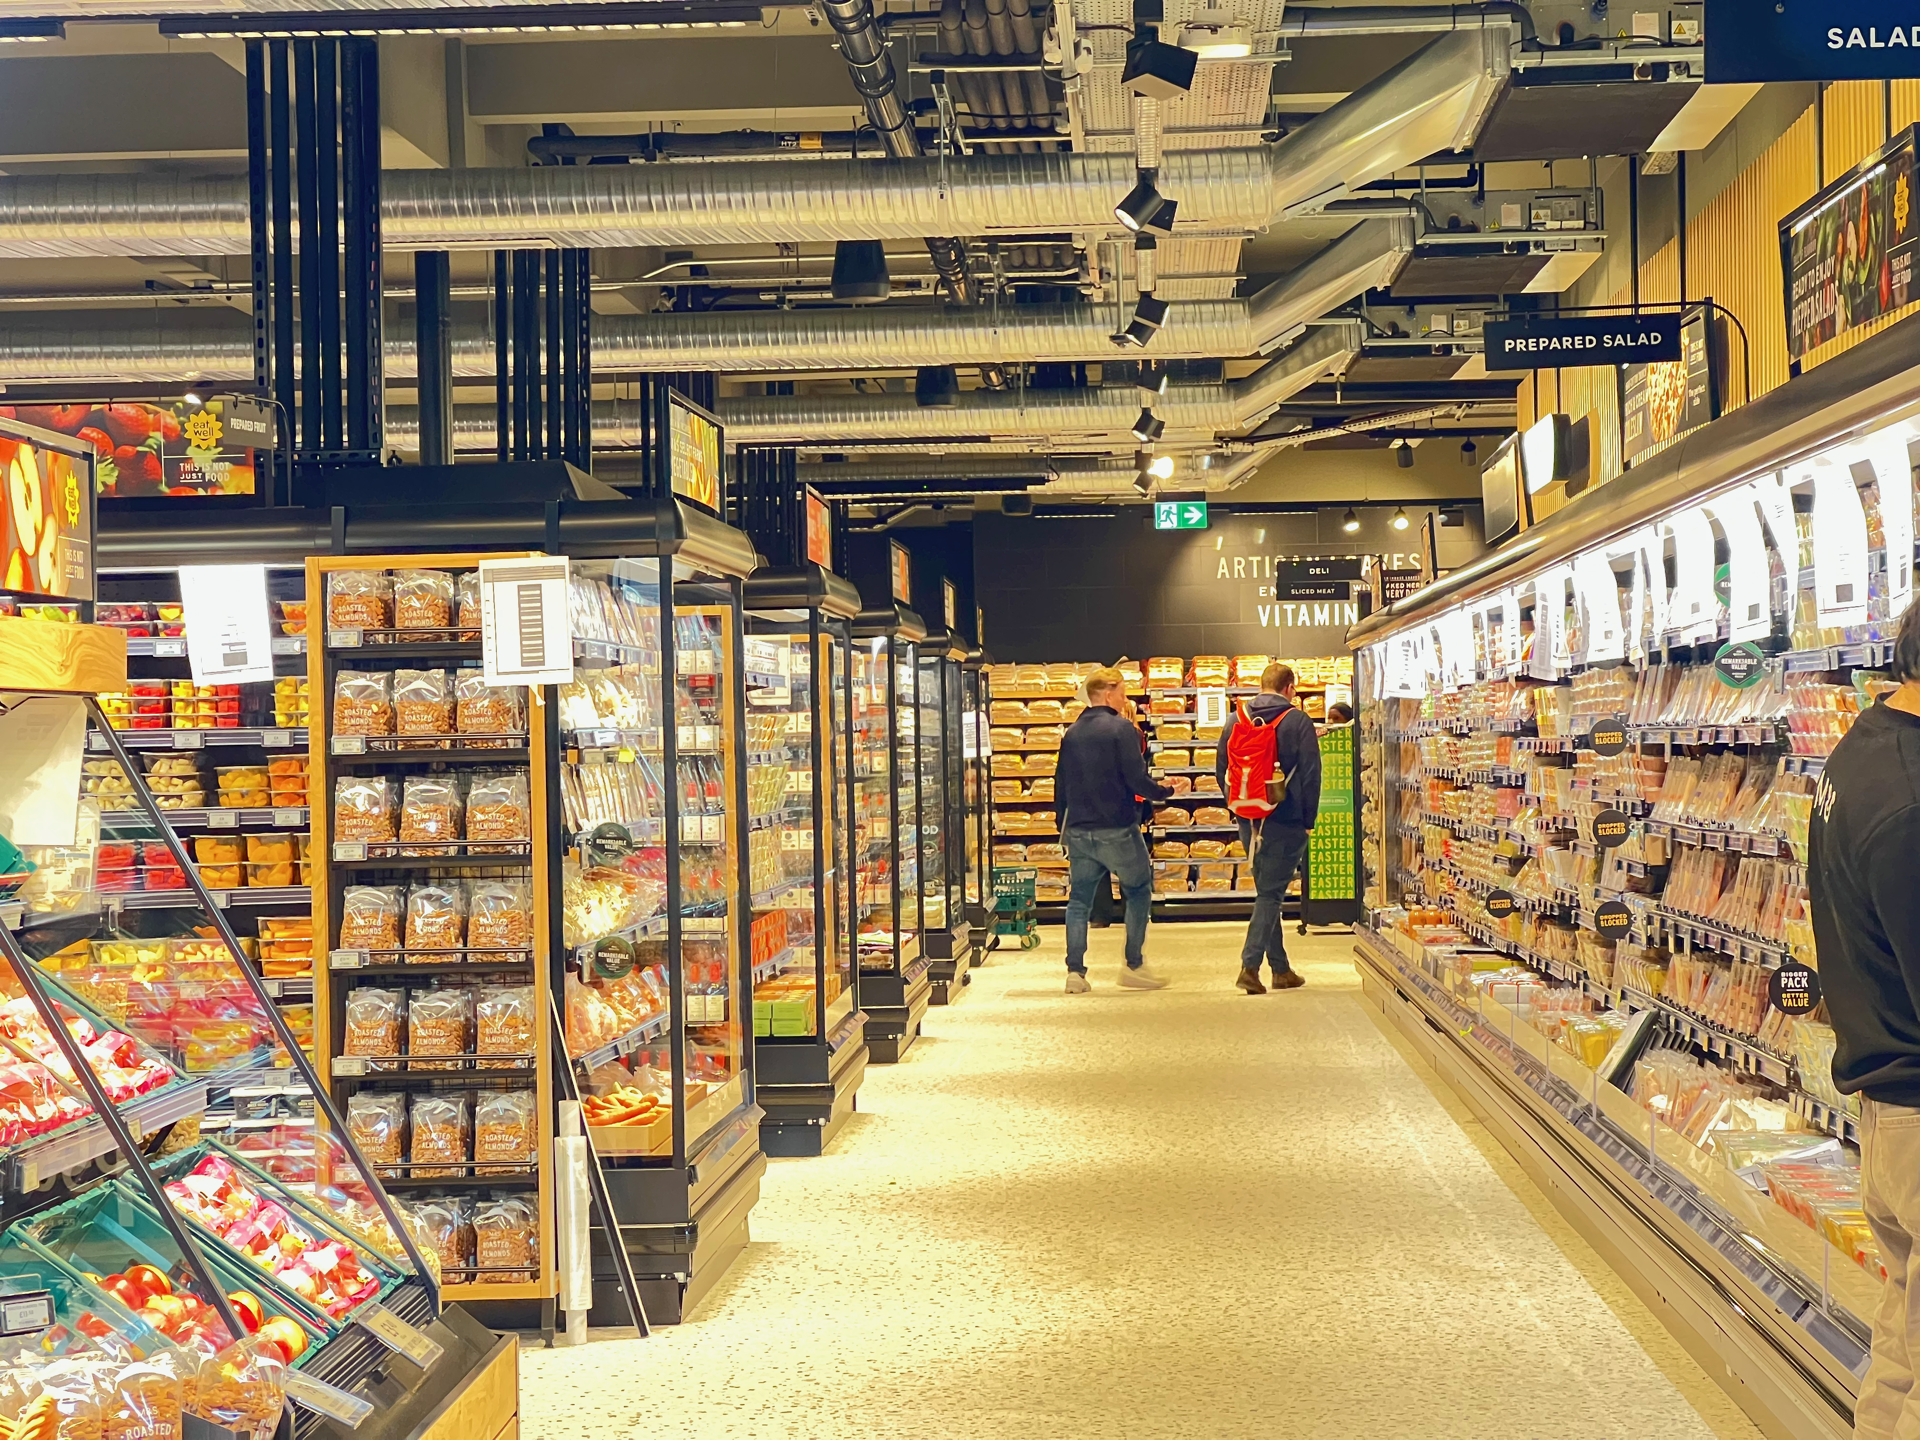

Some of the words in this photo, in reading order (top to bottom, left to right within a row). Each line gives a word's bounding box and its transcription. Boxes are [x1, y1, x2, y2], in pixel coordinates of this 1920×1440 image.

[1808, 268, 1815, 290] TO
[1815, 254, 1836, 285] ENJOY
[1815, 279, 1839, 324] SALADS
[1504, 336, 1597, 352] PREPARED
[1603, 332, 1662, 347] SALAD
[193, 420, 209, 430] eat
[230, 418, 253, 431] PREPARED
[253, 421, 266, 433] FRUIT
[193, 427, 214, 437] well
[179, 462, 199, 472] THIS
[201, 462, 211, 472] IS
[212, 462, 230, 471] NOT
[179, 472, 202, 480] JUST
[205, 472, 230, 482] FOOD
[1309, 567, 1330, 575] DELI
[1385, 589, 1404, 599] VERY
[338, 603, 367, 614] ROASTED
[338, 612, 368, 622] ALMONDS
[405, 610, 433, 619] ROASTED
[1257, 603, 1359, 627] VITAMIN
[405, 617, 434, 627] ALMONDS
[344, 708, 372, 718] ROASTED
[464, 708, 492, 717] ROASTED
[343, 716, 372, 725] ALMONDS
[404, 714, 433, 723] ROASTED
[464, 716, 493, 725] ALMONDS
[404, 723, 433, 731] ALMONDS
[1323, 753, 1352, 764] STER
[1323, 766, 1352, 777] STER
[1323, 779, 1352, 790] STER
[413, 813, 442, 821] ROASTED
[1317, 812, 1353, 823] ASTER
[345, 818, 374, 827] ROASTED
[475, 821, 505, 829] ALMONDS
[345, 826, 373, 835] ALMONDS
[1310, 838, 1353, 849] EASTER
[1310, 851, 1353, 862] EASTER
[1310, 864, 1353, 875] EASTER
[1310, 877, 1353, 888] EASTER
[479, 918, 508, 926] ROASTED
[352, 927, 382, 935] ALMONDS
[478, 926, 508, 934] ALMONDS
[1781, 976, 1809, 988] PACK
[1782, 998, 1809, 1007] VALUE
[354, 1028, 382, 1037] ROASTED
[353, 1037, 382, 1046] ALMONDS
[416, 1037, 445, 1045] ALMONDS
[485, 1035, 514, 1044] ALMONDS
[422, 1132, 451, 1141] ROASTED
[421, 1140, 451, 1149] ALMONDS
[485, 1142, 514, 1150] ALMONDS
[482, 1241, 510, 1249] ROASTED
[482, 1250, 511, 1258] ALMONDS
[126, 1423, 171, 1439] ROASTED
